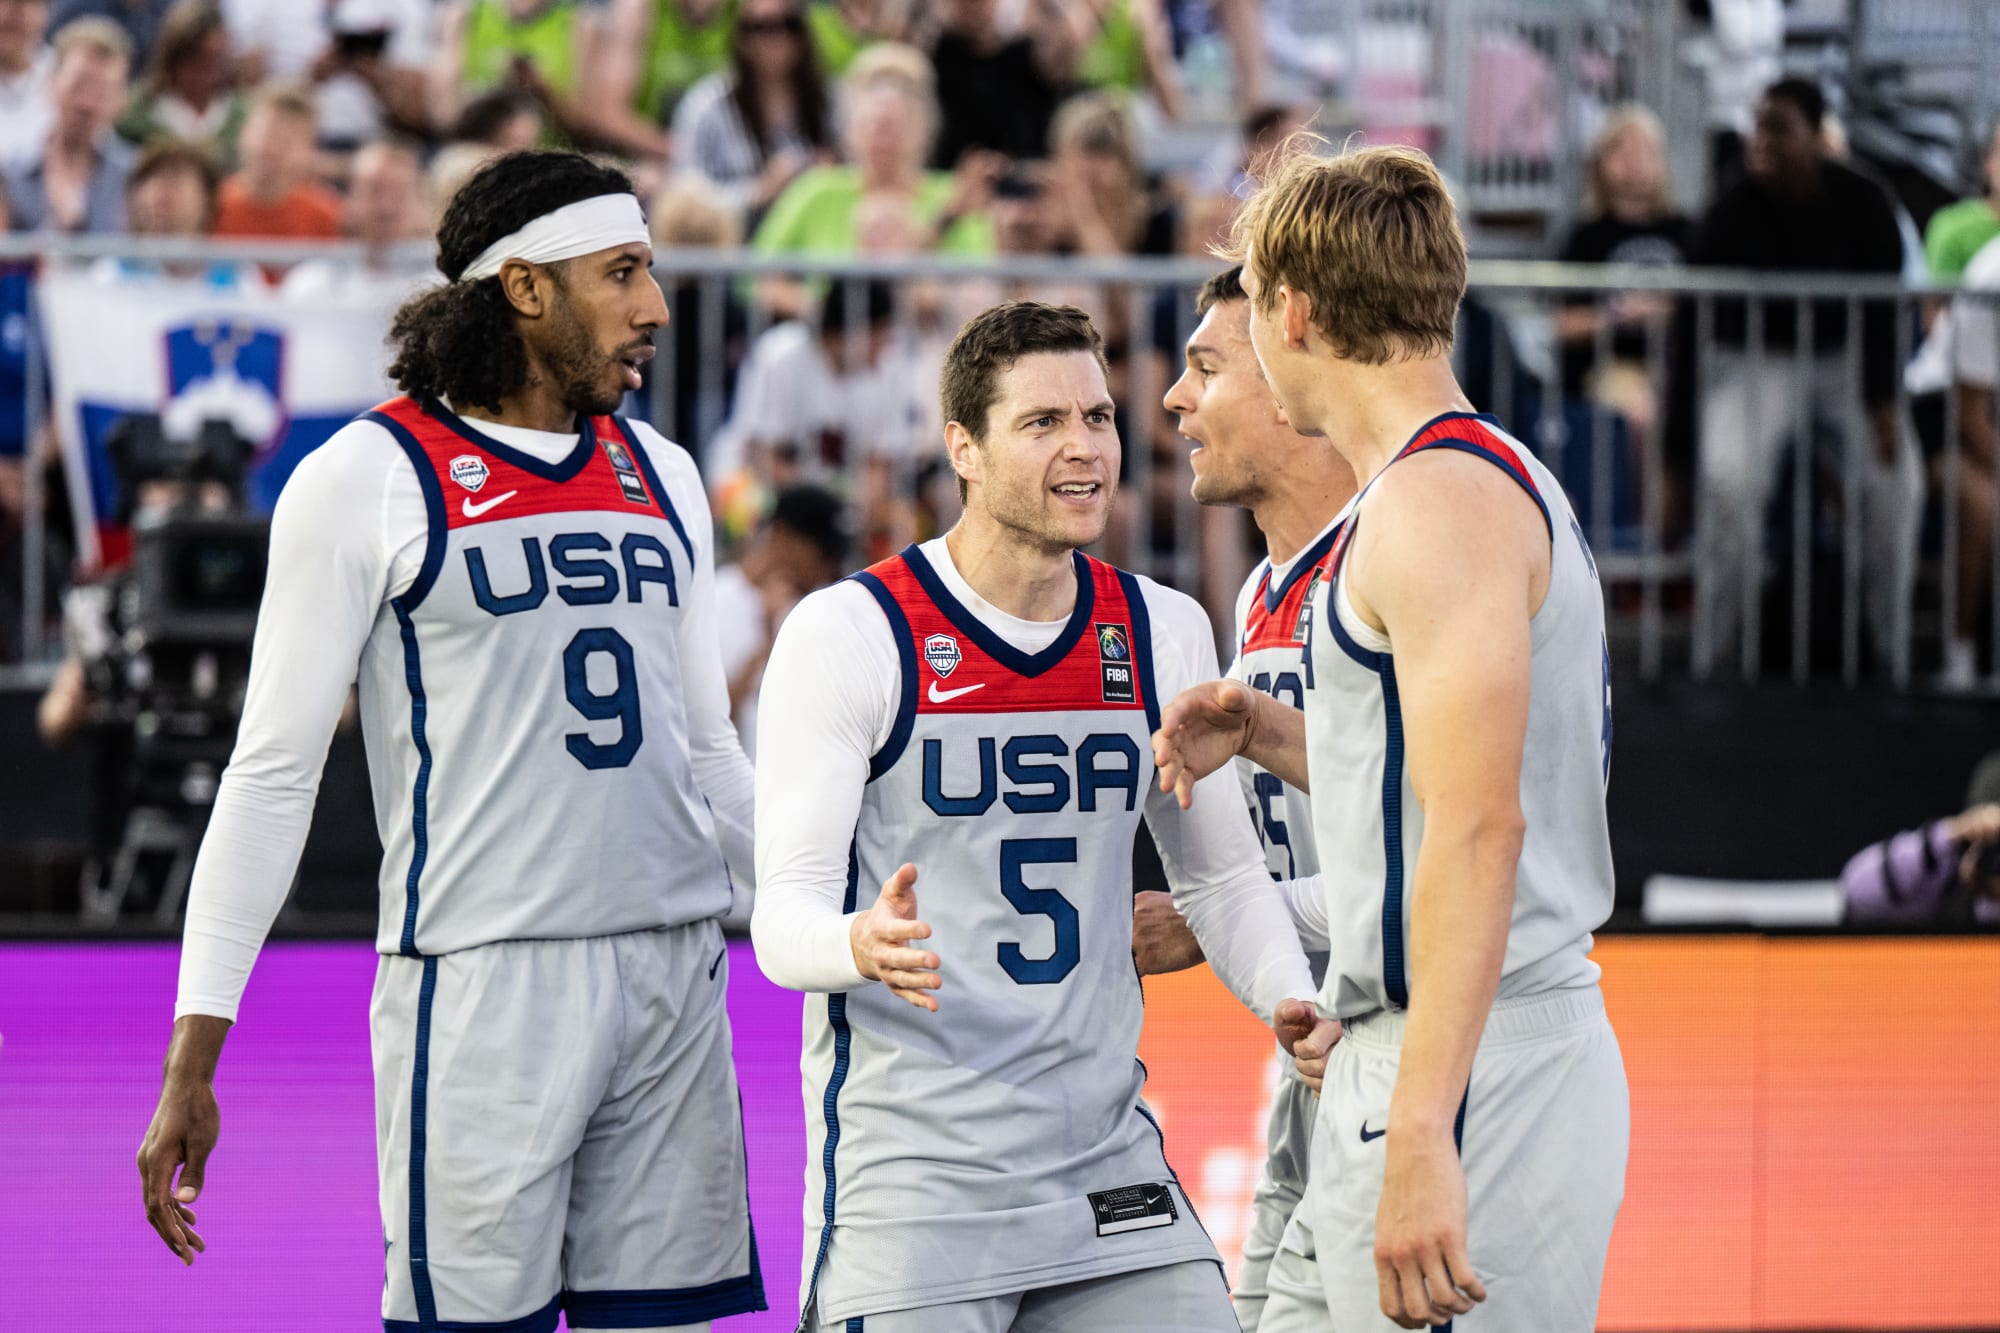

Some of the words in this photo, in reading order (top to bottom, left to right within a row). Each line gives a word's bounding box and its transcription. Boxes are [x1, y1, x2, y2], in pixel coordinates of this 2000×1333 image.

[464, 532, 679, 616] USA
[930, 641, 953, 652] USA
[1106, 668, 1129, 682] FIBA
[563, 627, 643, 770] 9
[922, 733, 1140, 816] USA
[997, 837, 1080, 985] 5
